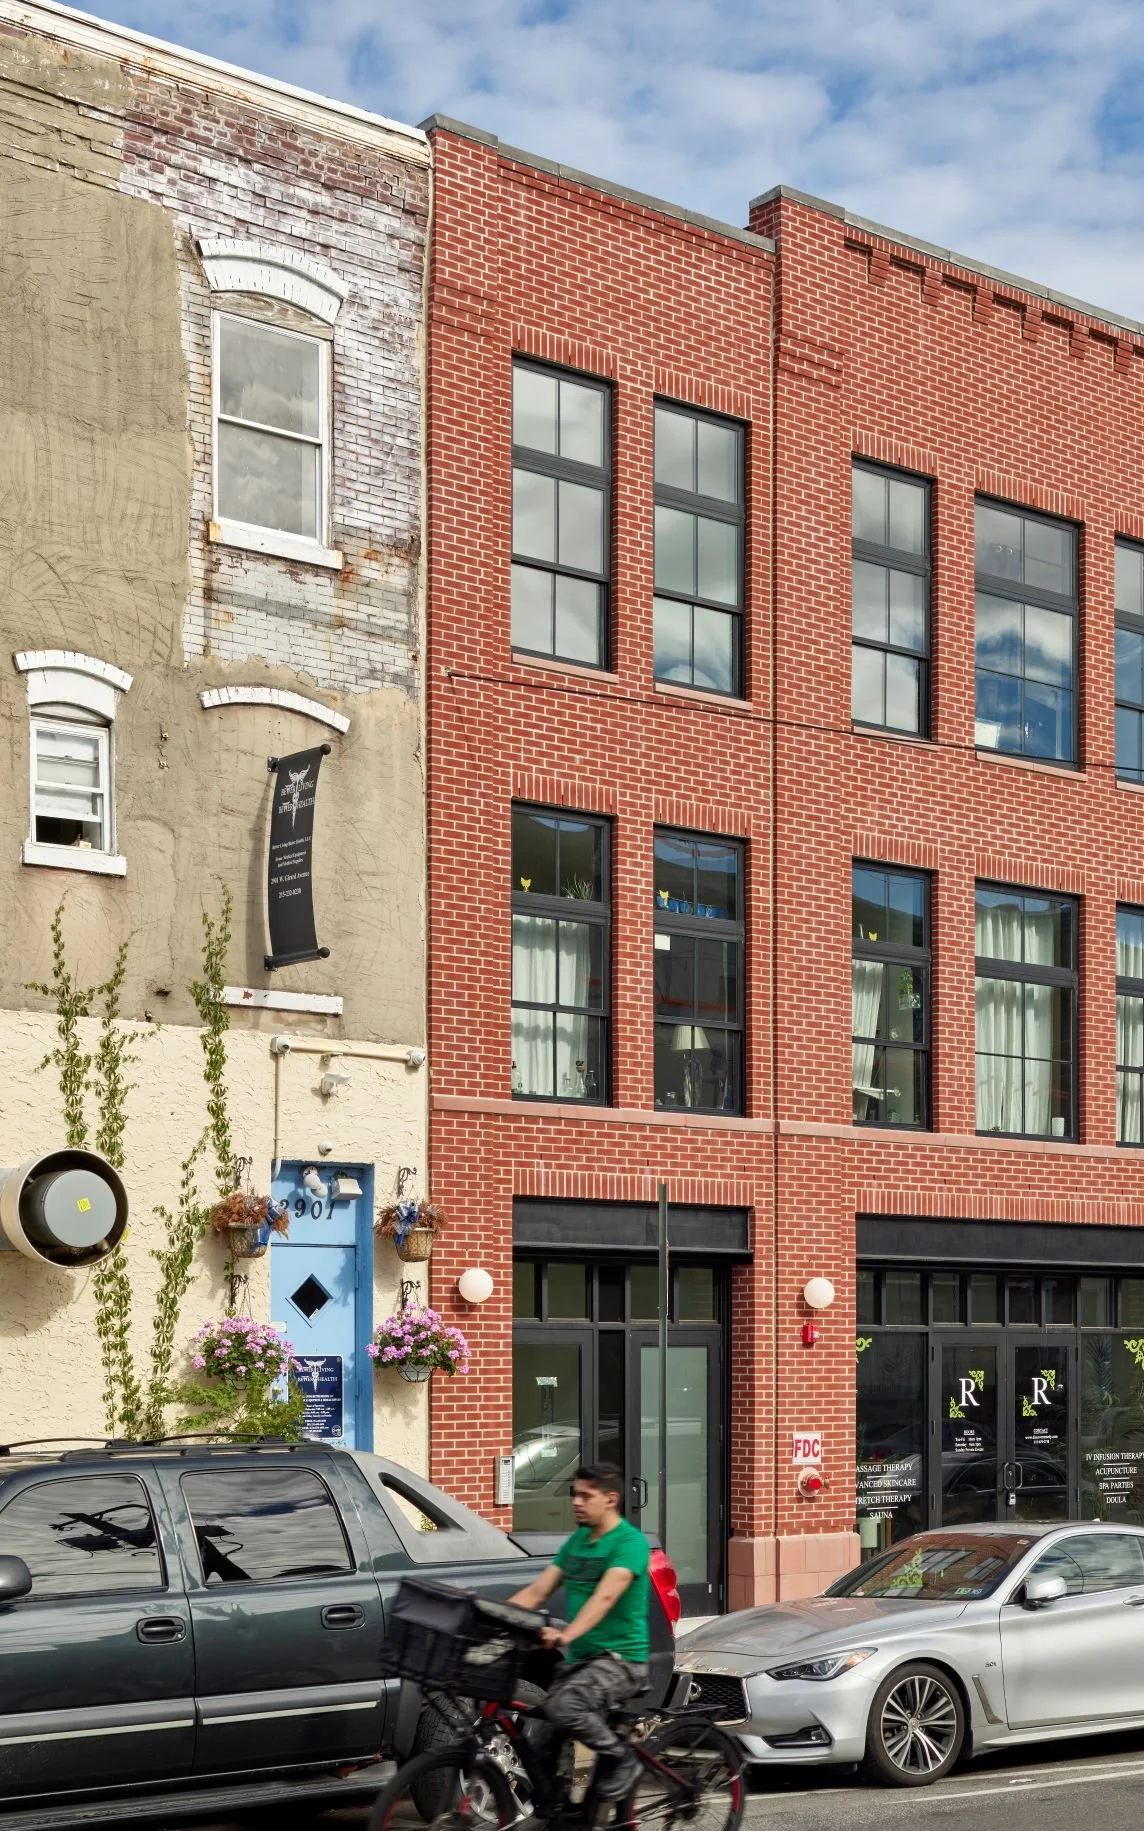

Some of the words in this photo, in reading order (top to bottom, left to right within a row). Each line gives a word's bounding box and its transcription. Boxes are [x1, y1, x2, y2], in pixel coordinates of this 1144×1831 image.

[958, 1378, 980, 1406] R
[1031, 1377, 1052, 1405] R
[794, 1439, 820, 1458] FDC
[1085, 1453, 1093, 1461] IV
[1093, 1452, 1120, 1461] INFUSION
[856, 1465, 882, 1473] ASSAGE
[883, 1463, 913, 1472] THERAPY
[1095, 1467, 1138, 1475] ACUPUNCTURE
[856, 1480, 883, 1489] VANCED
[883, 1479, 917, 1488] SKINCARE
[1099, 1482, 1109, 1490] SPA
[1110, 1481, 1134, 1489] PARTIES
[856, 1496, 880, 1504] TRETCH
[881, 1494, 912, 1503] THERAPY
[1106, 1496, 1127, 1504] DOULA
[869, 1511, 894, 1520] SAUNA
